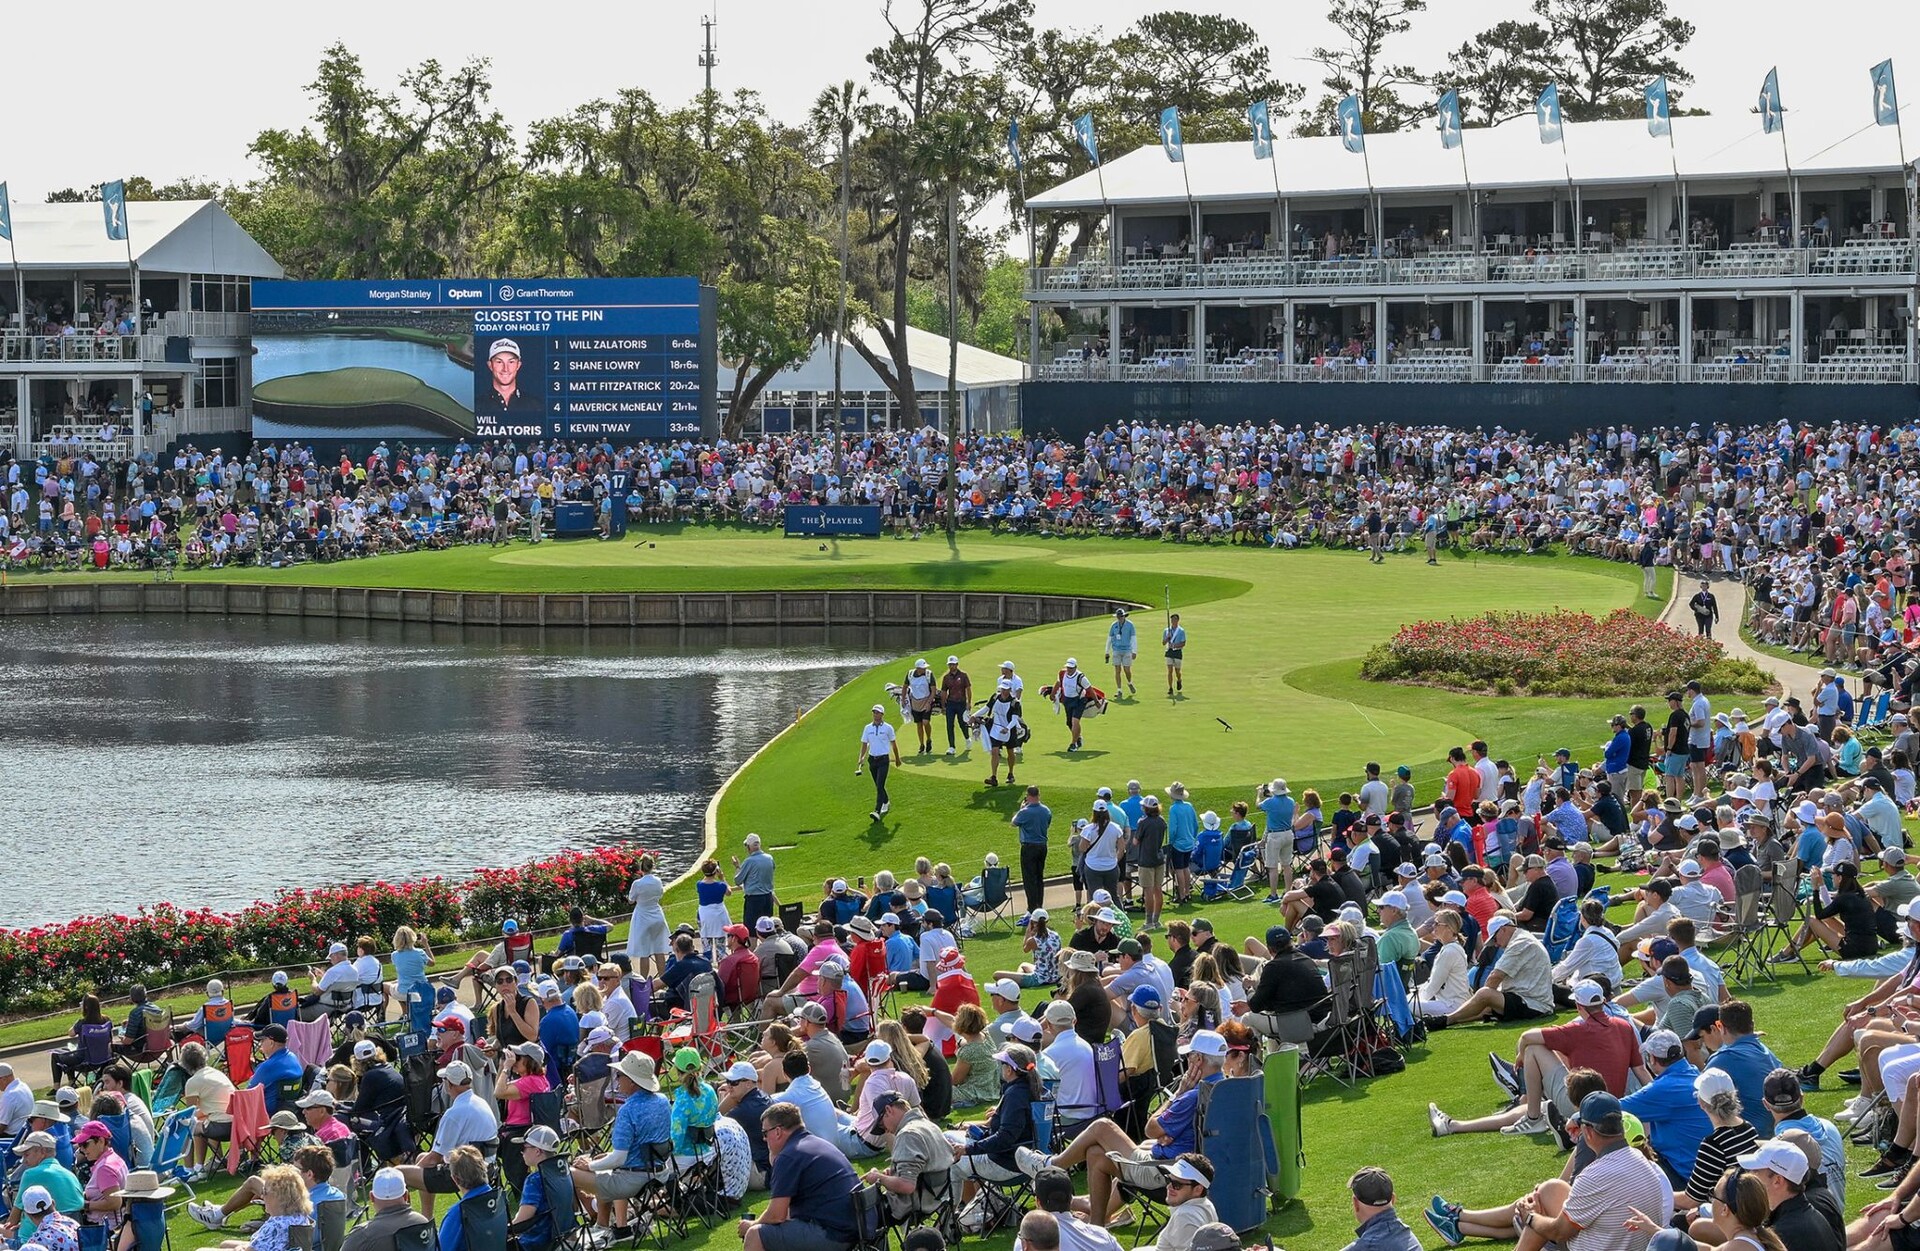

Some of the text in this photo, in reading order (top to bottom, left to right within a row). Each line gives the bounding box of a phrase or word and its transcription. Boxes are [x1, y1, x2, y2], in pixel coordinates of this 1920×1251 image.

[369, 289, 432, 300] Morgan Stanley
[448, 289, 483, 300] Optum
[474, 310, 603, 322] CLOSEST TO THE PIN
[474, 323, 550, 332] TODAY ON HOLE 17
[554, 340, 559, 350] 1
[569, 340, 592, 350] WILL
[593, 340, 647, 349] ZALATORIS
[553, 360, 560, 371] 2
[569, 361, 603, 370] SHANE
[605, 361, 641, 370] LOWRY
[553, 381, 561, 391] 3
[569, 382, 597, 391] MATT
[599, 381, 662, 391] FITZPATRICK
[553, 402, 561, 412] 4
[569, 402, 618, 412] MAVERICK
[620, 402, 663, 412] McNEALY
[476, 415, 498, 424] WILL
[476, 425, 542, 436] ZALATORIS
[554, 423, 561, 433] 5
[570, 423, 599, 433] KEVIN
[601, 423, 631, 432] TWAY
[611, 474, 626, 489] 17
[826, 517, 863, 525] PLAYERS
